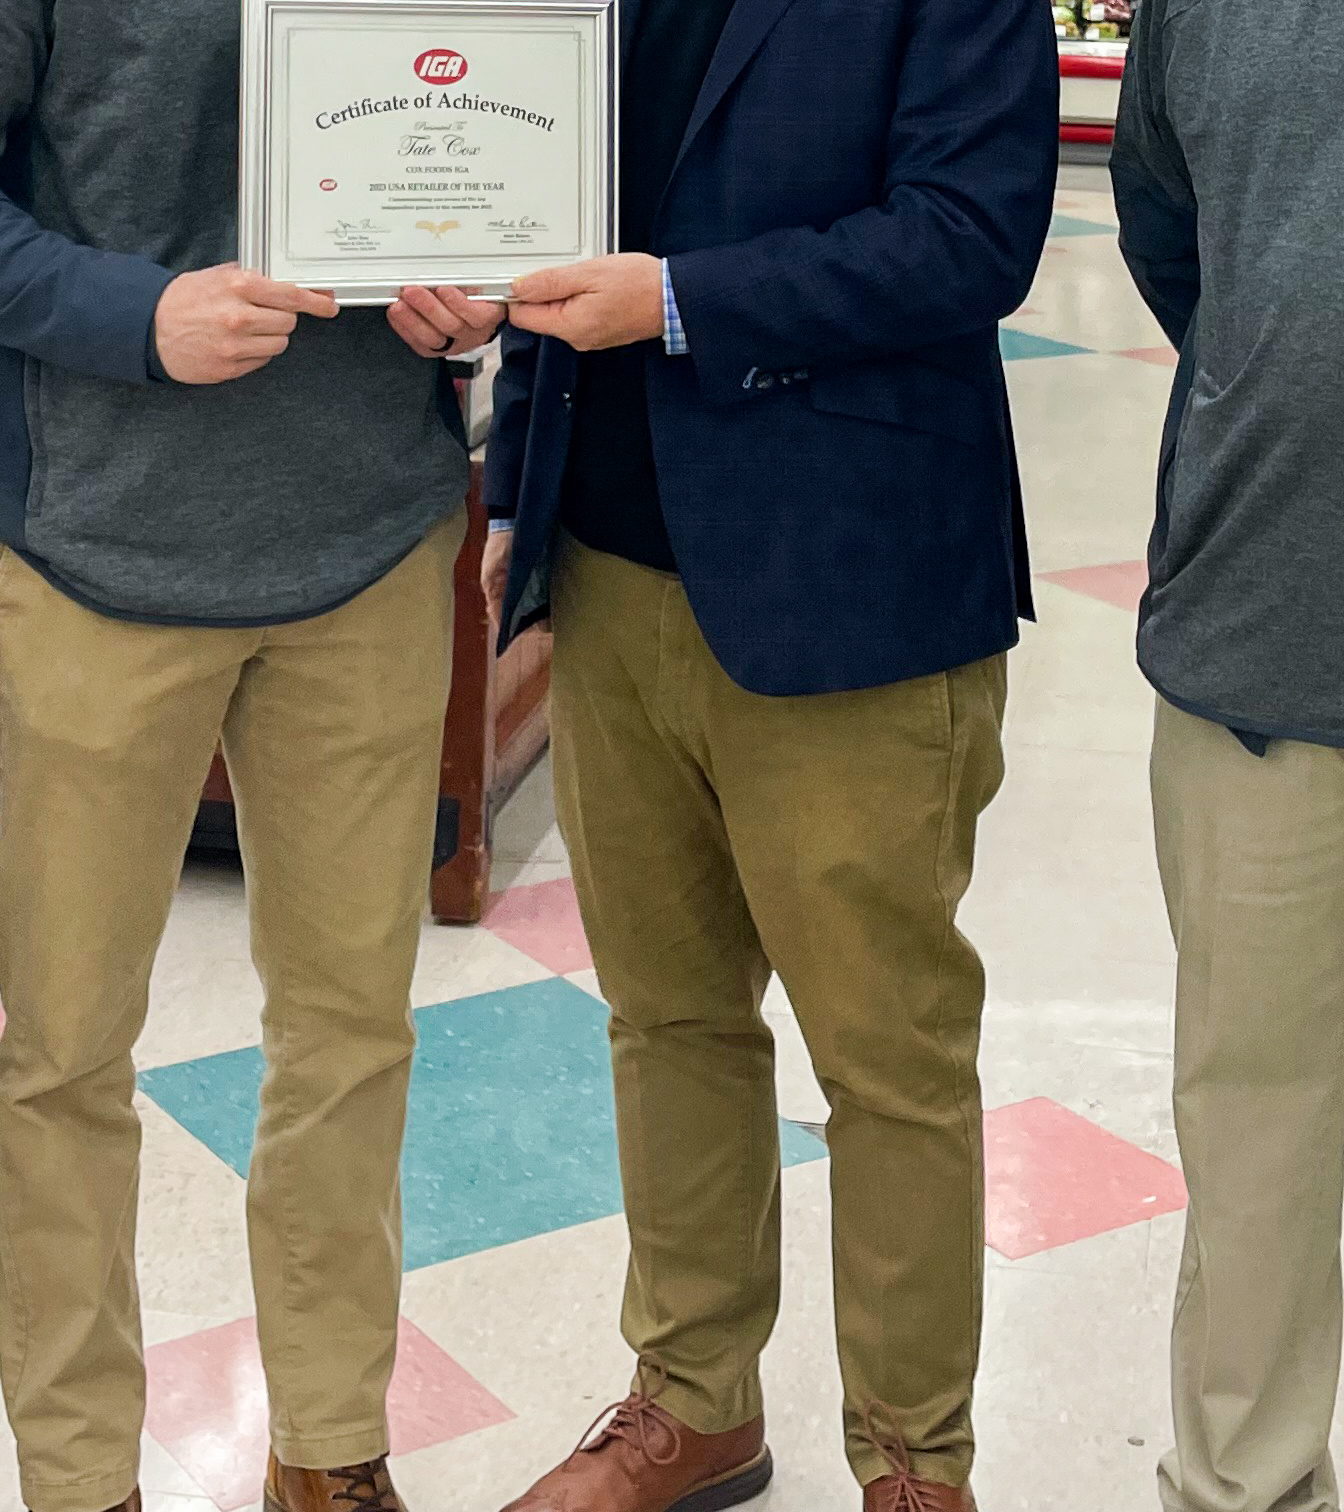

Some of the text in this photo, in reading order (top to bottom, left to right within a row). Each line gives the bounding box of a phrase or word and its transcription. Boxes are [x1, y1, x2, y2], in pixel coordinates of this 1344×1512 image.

[419, 55, 464, 77] IGA
[315, 91, 555, 132] Certificate of Achievement
[397, 134, 481, 156] Tate Cox
[388, 183, 406, 192] USA
[408, 183, 449, 192] RETAILER
[464, 183, 481, 192] THE
[482, 183, 505, 191] YEAR
